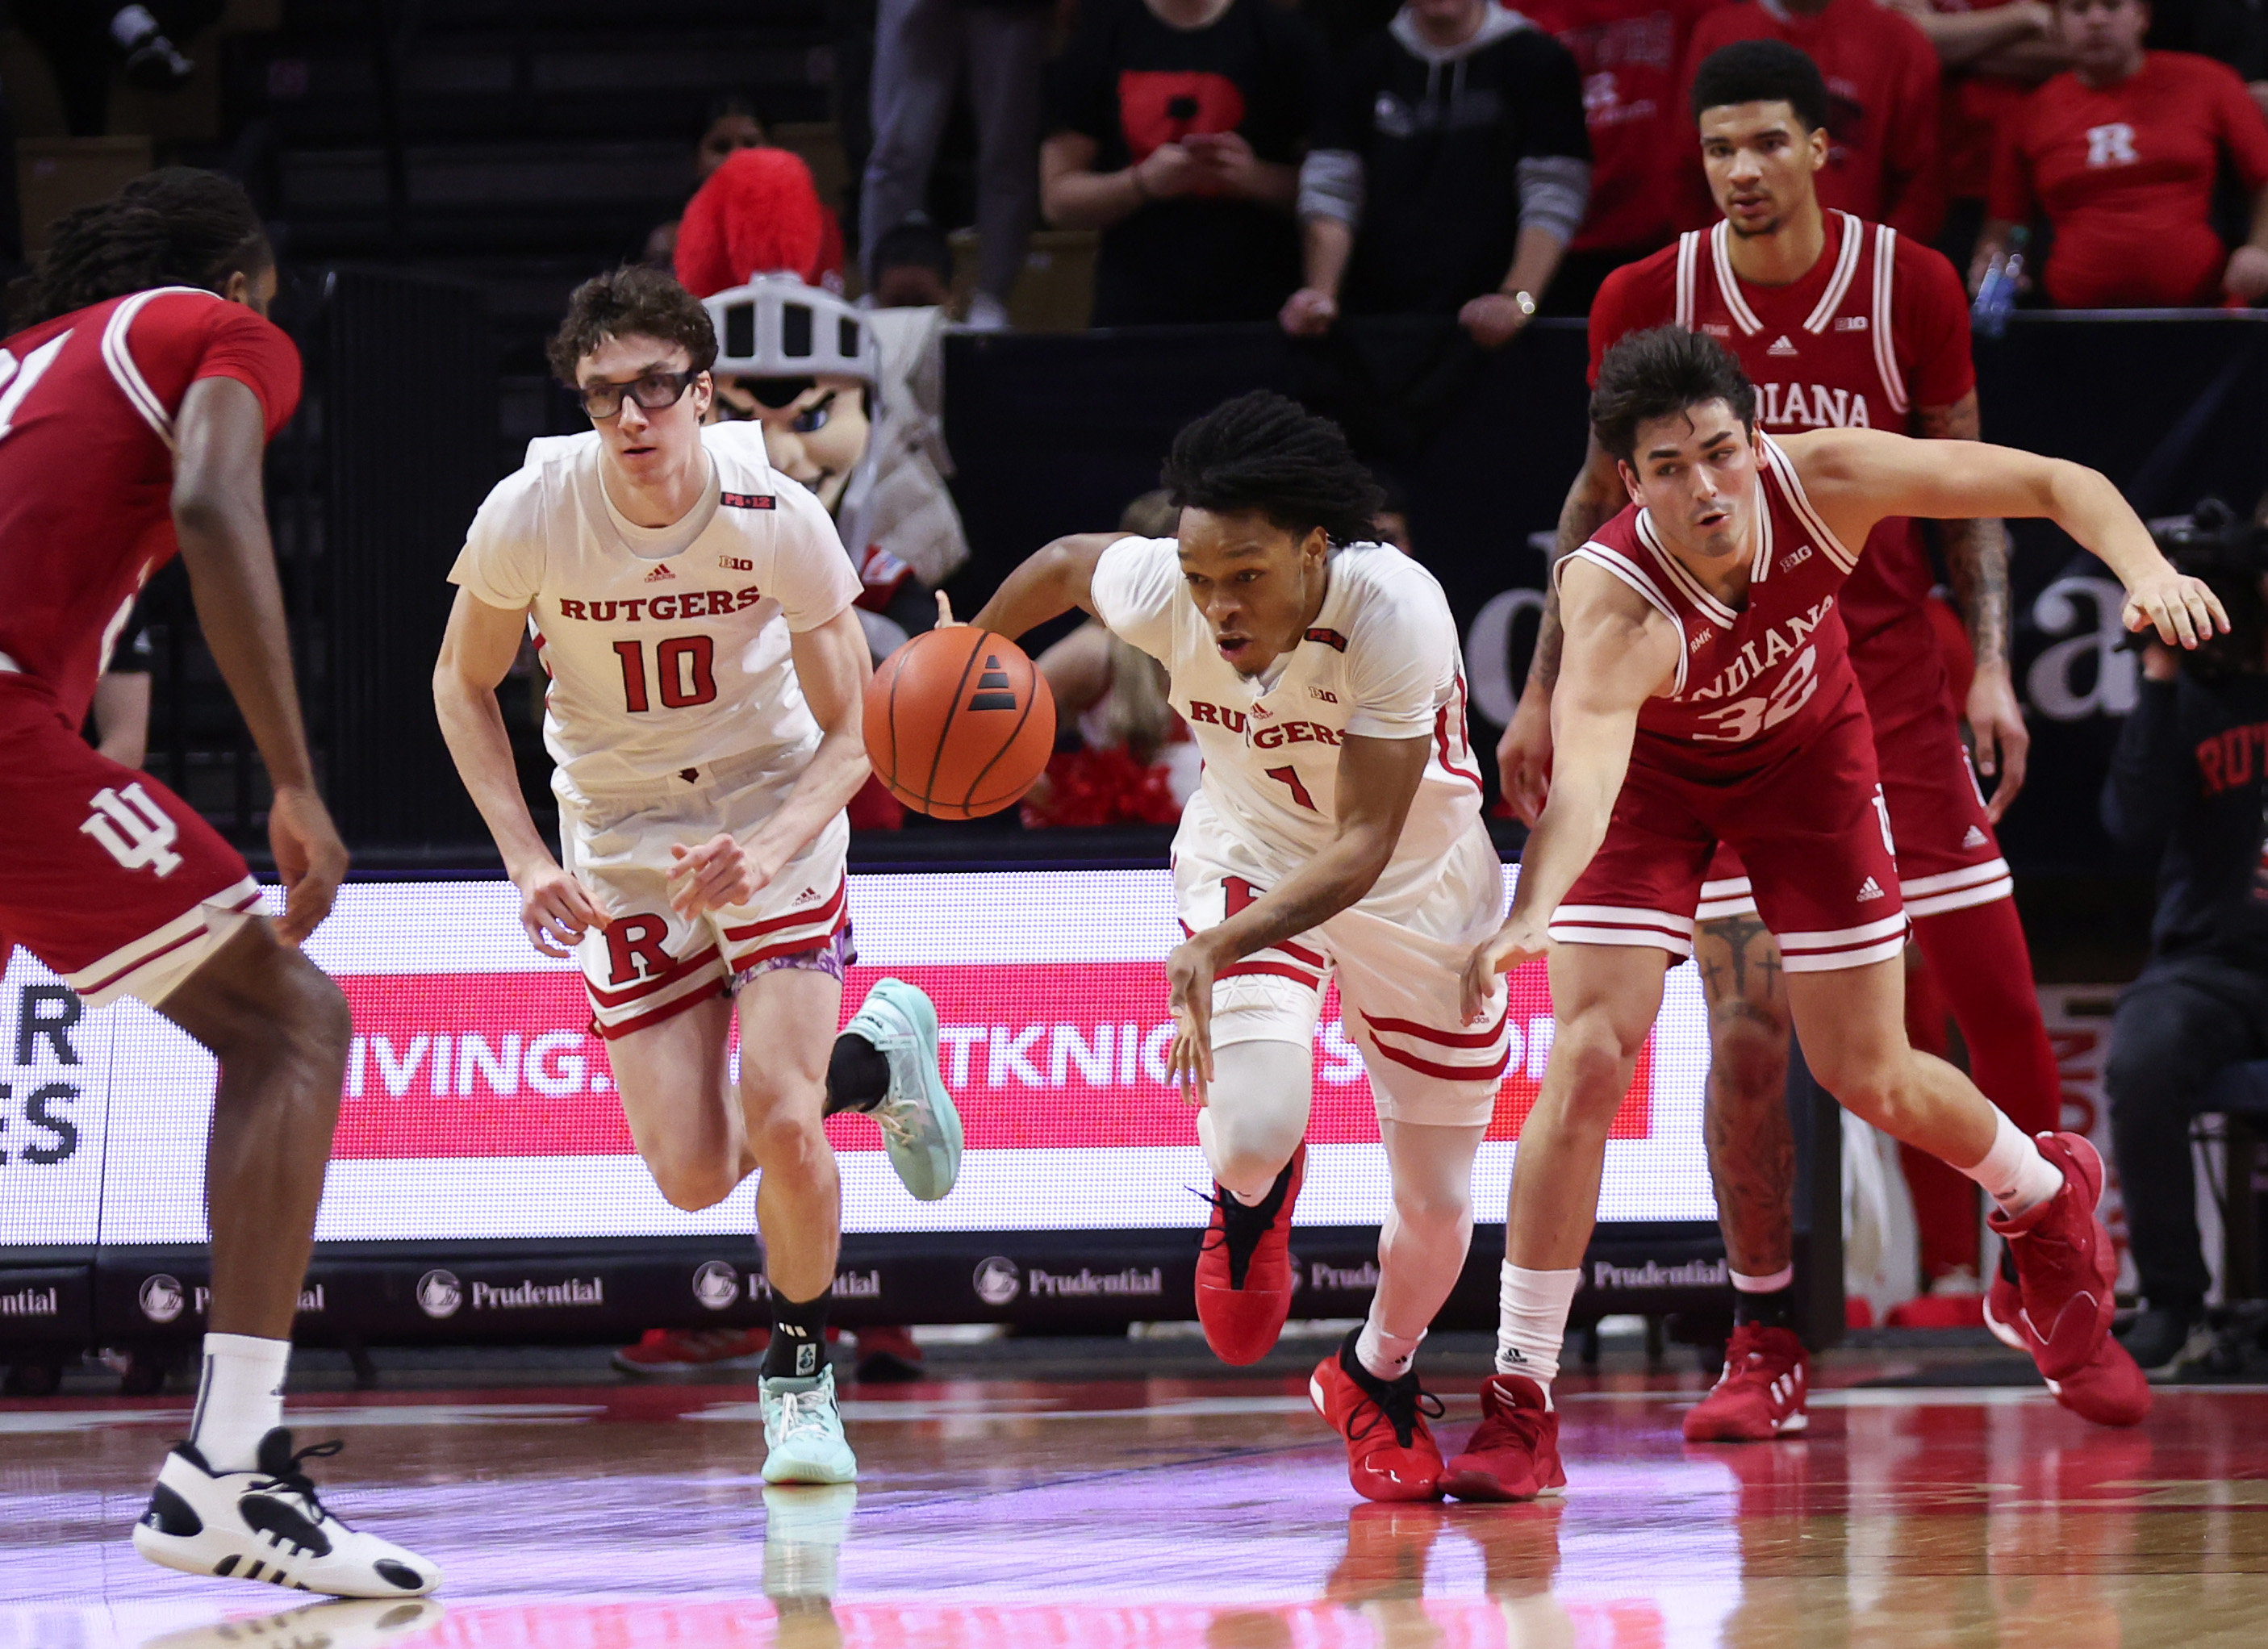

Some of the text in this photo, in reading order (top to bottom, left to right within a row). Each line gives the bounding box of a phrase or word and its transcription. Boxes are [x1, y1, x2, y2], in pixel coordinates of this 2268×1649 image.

[0, 328, 75, 440] 1
[560, 586, 760, 621] RUTGERS
[612, 635, 717, 712] 10
[1692, 645, 1818, 742] 32
[1189, 700, 1346, 749] RUGER
[602, 912, 679, 986] R
[0, 1083, 81, 1164] S
[472, 1277, 604, 1309] Prudential
[1029, 1267, 1162, 1296] Prudential
[1593, 1259, 1729, 1289] Prudential
